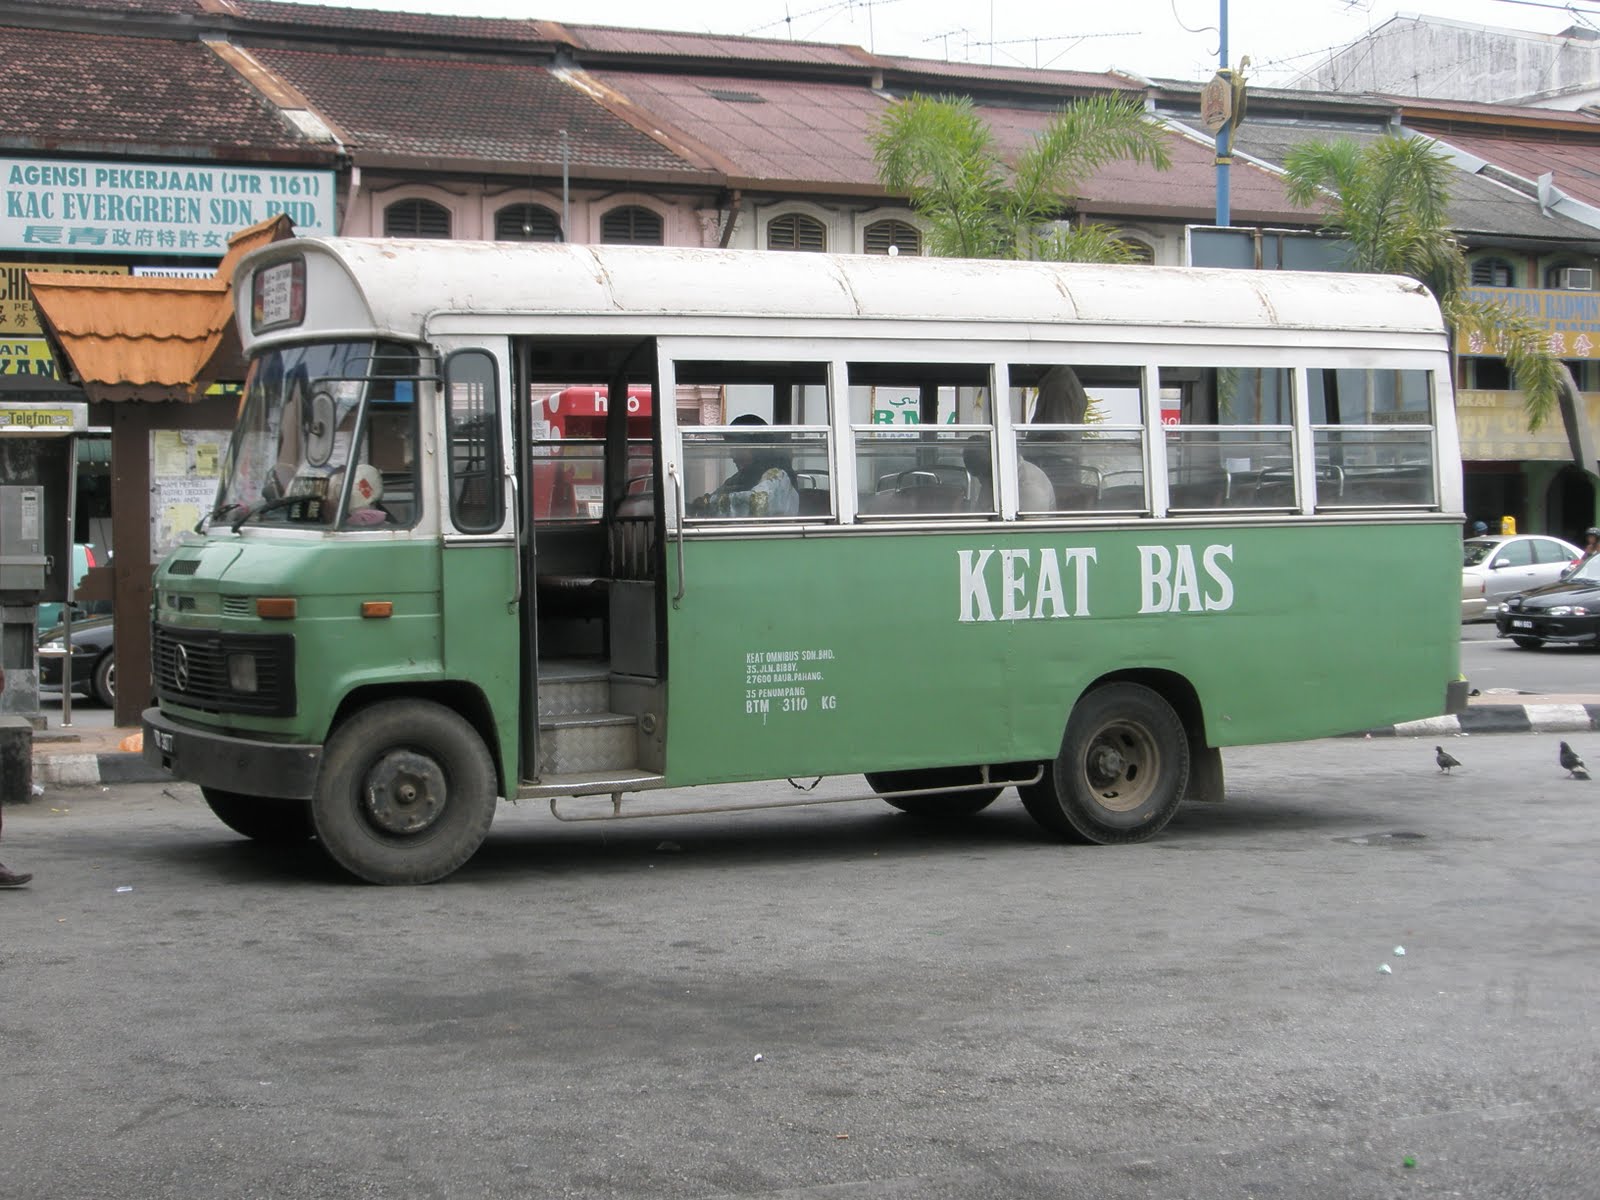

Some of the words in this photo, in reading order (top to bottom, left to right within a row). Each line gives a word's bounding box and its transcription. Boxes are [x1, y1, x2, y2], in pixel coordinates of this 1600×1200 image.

[9, 165, 87, 187] AGENSI
[95, 168, 213, 192] PEKERJAAN
[221, 172, 262, 194] (JTR
[270, 175, 320, 197] 1161)
[7, 190, 55, 220] KAC
[62, 192, 201, 225] EVERGREEN
[209, 198, 259, 226] SDN.
[8, 411, 52, 425] Telefon
[957, 547, 1097, 621] KEAT
[1137, 544, 1234, 613] BAS
[746, 652, 764, 663] KEAT
[766, 651, 799, 662] OMNIBUS
[746, 674, 772, 684] 27600
[746, 689, 756, 698] 35
[758, 687, 806, 697] PENUMPANG
[746, 699, 770, 713] BTM
[782, 698, 808, 711] 3110
[821, 696, 837, 709] KG
